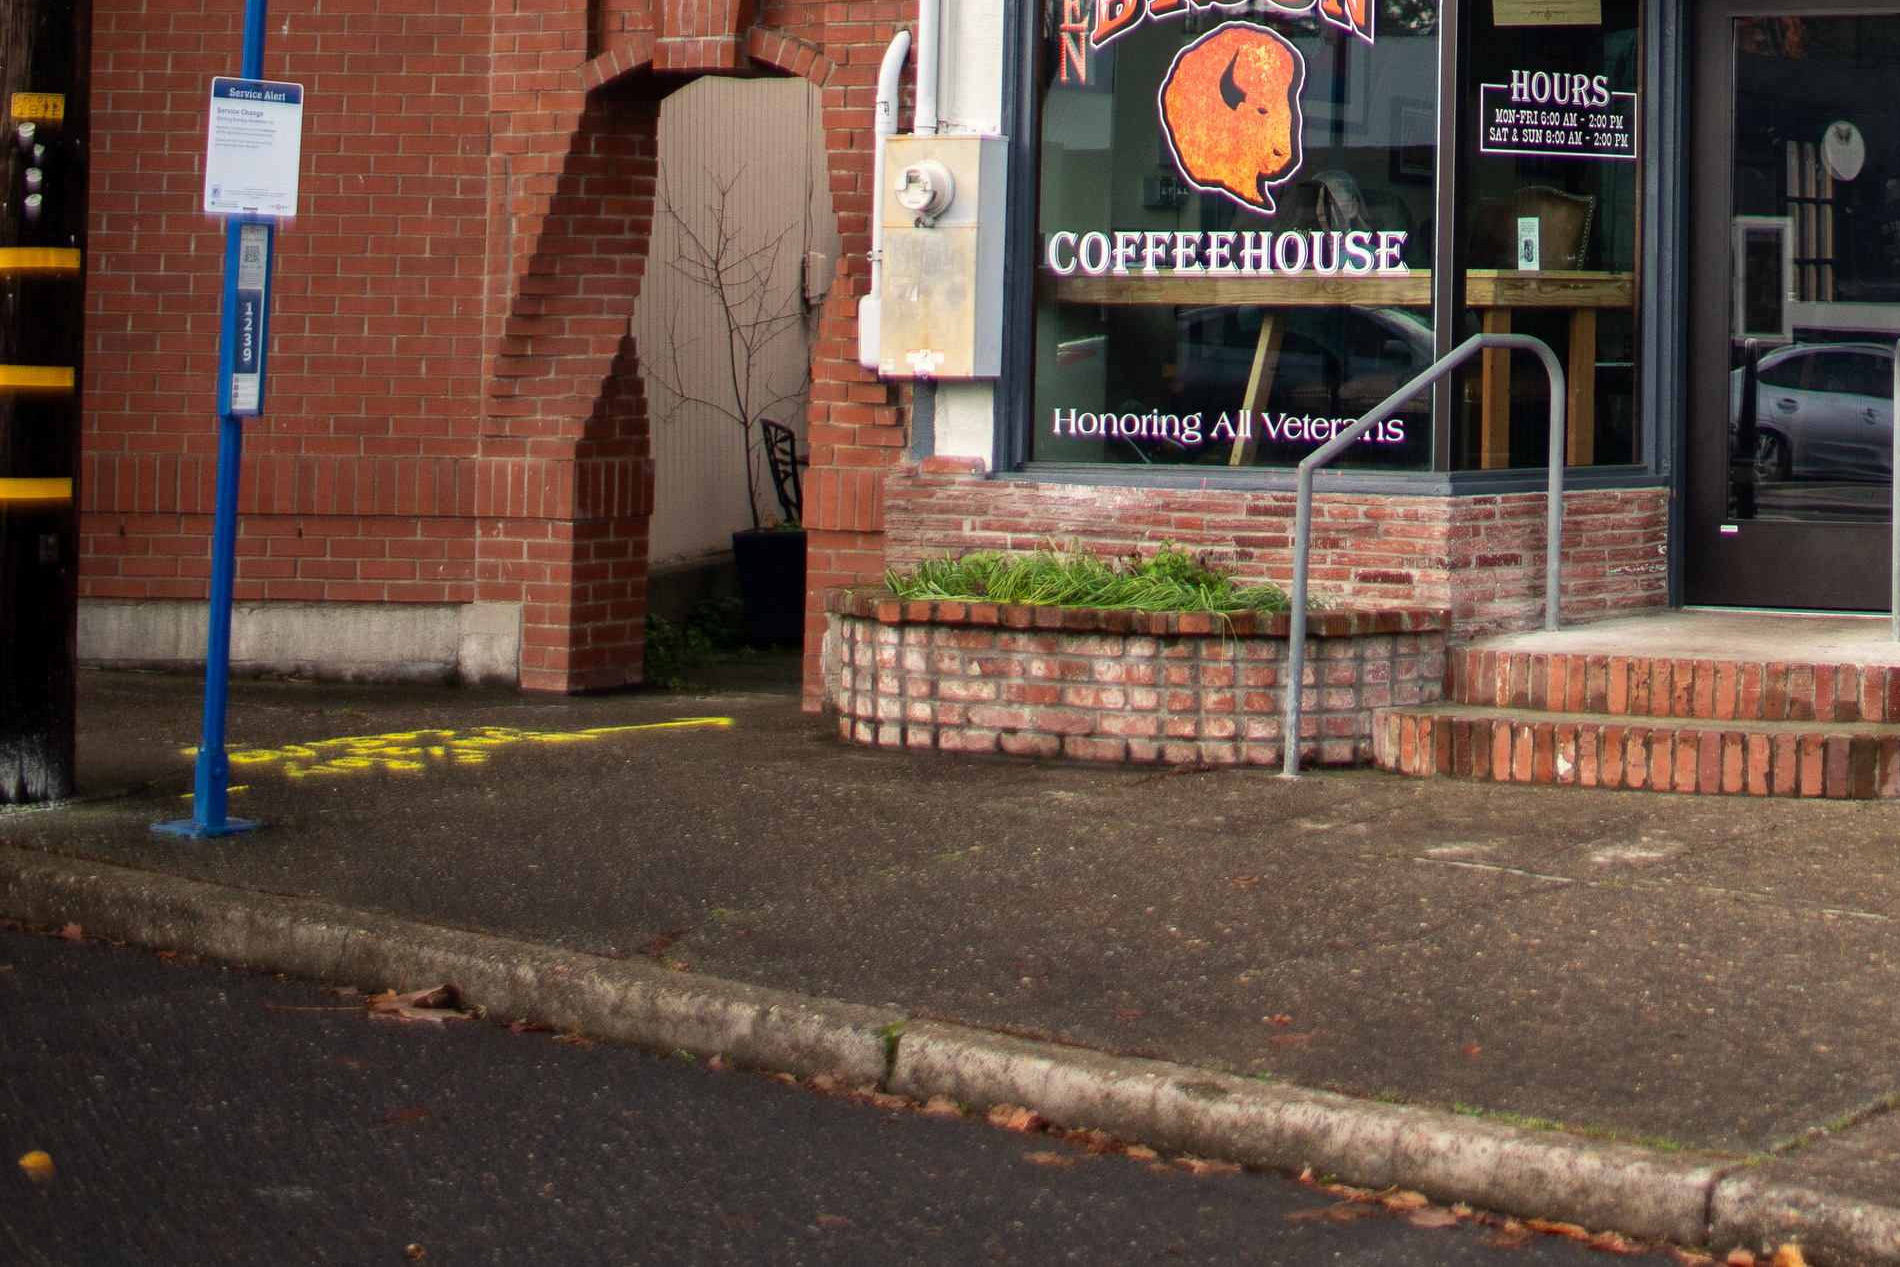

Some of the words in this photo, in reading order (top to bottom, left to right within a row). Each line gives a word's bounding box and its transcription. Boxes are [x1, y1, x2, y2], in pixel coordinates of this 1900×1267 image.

[229, 87, 262, 100] Service
[264, 90, 286, 101] Alert
[1510, 69, 1610, 108] HOURS
[217, 106, 240, 115] Service
[241, 108, 264, 118] Change
[1495, 108, 1538, 124] MON-FRI
[1540, 113, 1560, 126] 6:00
[1562, 113, 1577, 127] AM
[1588, 114, 1607, 128] 2:00
[1610, 115, 1623, 129] PM
[1489, 127, 1508, 142] SAT
[1511, 129, 1518, 142] &
[1522, 129, 1543, 143] SUN
[1545, 130, 1565, 144] 8:00
[1567, 131, 1582, 145] AM
[1594, 133, 1612, 146] 2:00
[1614, 133, 1628, 147] PM
[1049, 230, 1411, 275] COFFEEHOUSE
[243, 301, 254, 362] 1239
[1053, 407, 1202, 443] Honoring
[1210, 408, 1252, 437] All
